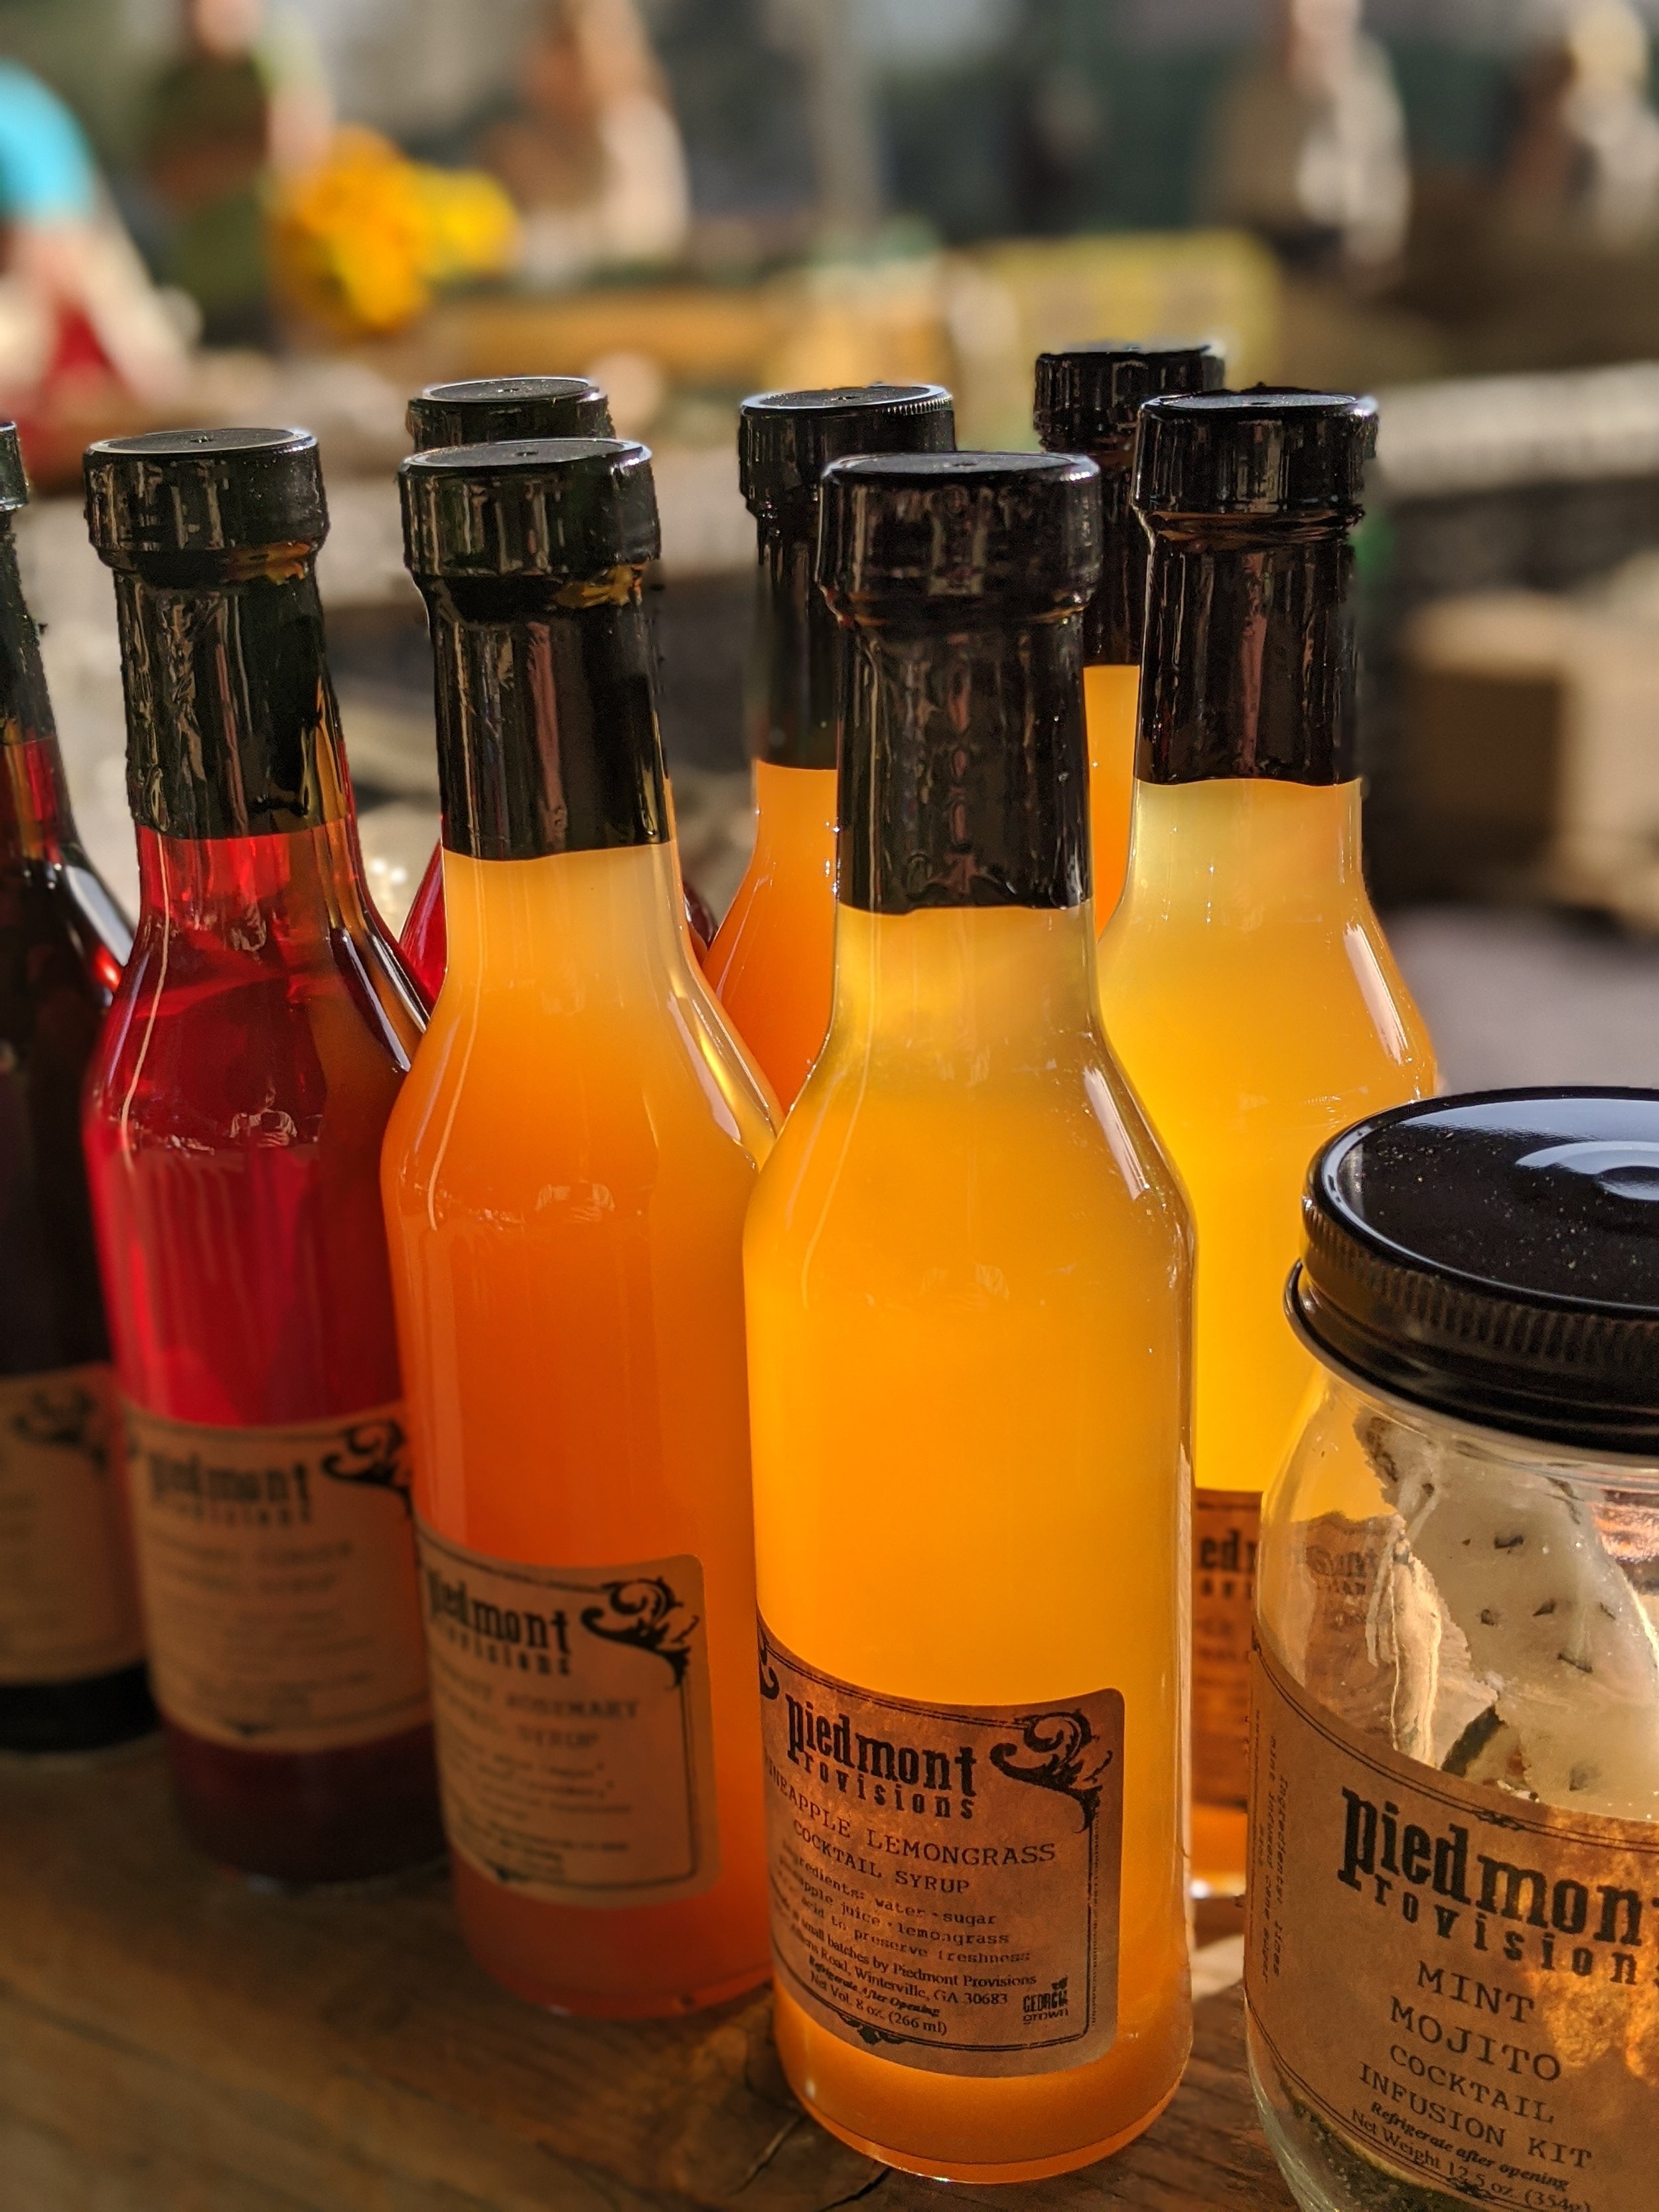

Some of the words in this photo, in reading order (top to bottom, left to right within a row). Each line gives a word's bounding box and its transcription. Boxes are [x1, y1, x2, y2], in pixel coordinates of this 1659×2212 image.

[785, 1693, 977, 1796] piedmont
[792, 1820, 881, 1878] COCKTAIL
[895, 1870, 970, 1893] SYRUP
[866, 1828, 1055, 1866] LEMONGRASS
[1338, 1787, 1659, 1946] piedmon
[841, 1901, 881, 1925] juice
[898, 1922, 1009, 1946] lemongrass
[854, 1929, 928, 1956] preserve
[875, 1897, 925, 1917] water
[943, 1911, 997, 1927] sugar
[828, 1933, 869, 1964] batches
[873, 1956, 889, 1972] by
[893, 1962, 958, 1986] Piedmont
[964, 1974, 1037, 1988] Provisions
[1417, 1960, 1534, 2023] MINT
[934, 1988, 960, 2004] GA
[964, 1992, 1008, 2005] 30683
[1391, 1996, 1561, 2083] MOJITO
[1359, 2061, 1505, 2148] INFUSION
[1528, 2136, 1592, 2169] KIT
[1390, 2044, 1555, 2124] COCKTAIL
[1371, 2102, 1453, 2152] Refrigerate
[1456, 2148, 1494, 2167] after
[1500, 2164, 1569, 2191] opening
